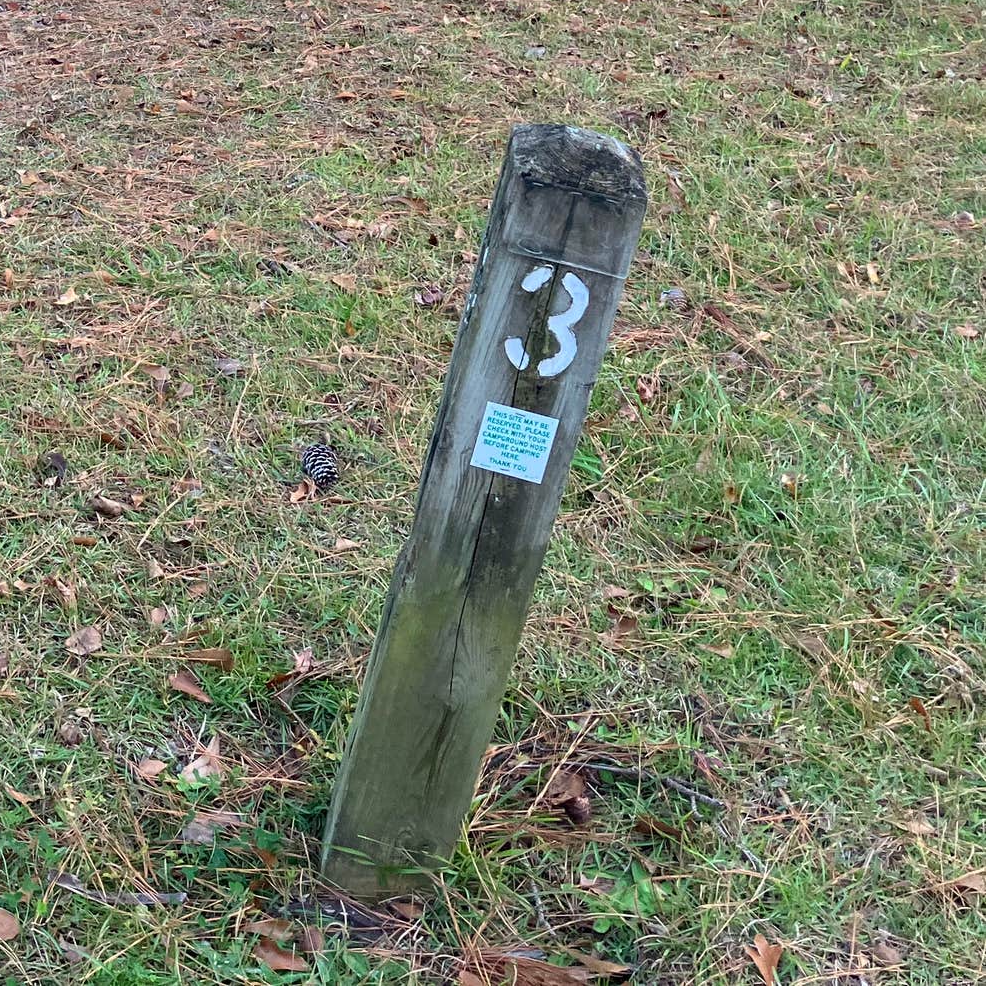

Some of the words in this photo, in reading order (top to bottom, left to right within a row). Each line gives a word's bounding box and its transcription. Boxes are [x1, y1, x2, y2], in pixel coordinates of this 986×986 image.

[504, 267, 590, 377] 3
[494, 410, 507, 419] THIS
[509, 414, 521, 423] SITE
[524, 418, 538, 426] MAY
[488, 425, 509, 434] CHECK
[511, 431, 526, 439] WITH
[529, 435, 546, 443] YOUR
[525, 426, 550, 438] PLEASE
[483, 431, 528, 447] CAMPGROUND
[530, 444, 547, 452] HOST
[484, 439, 508, 450] BEFORE
[511, 446, 540, 458] CAMPING
[490, 458, 510, 467] THANK
